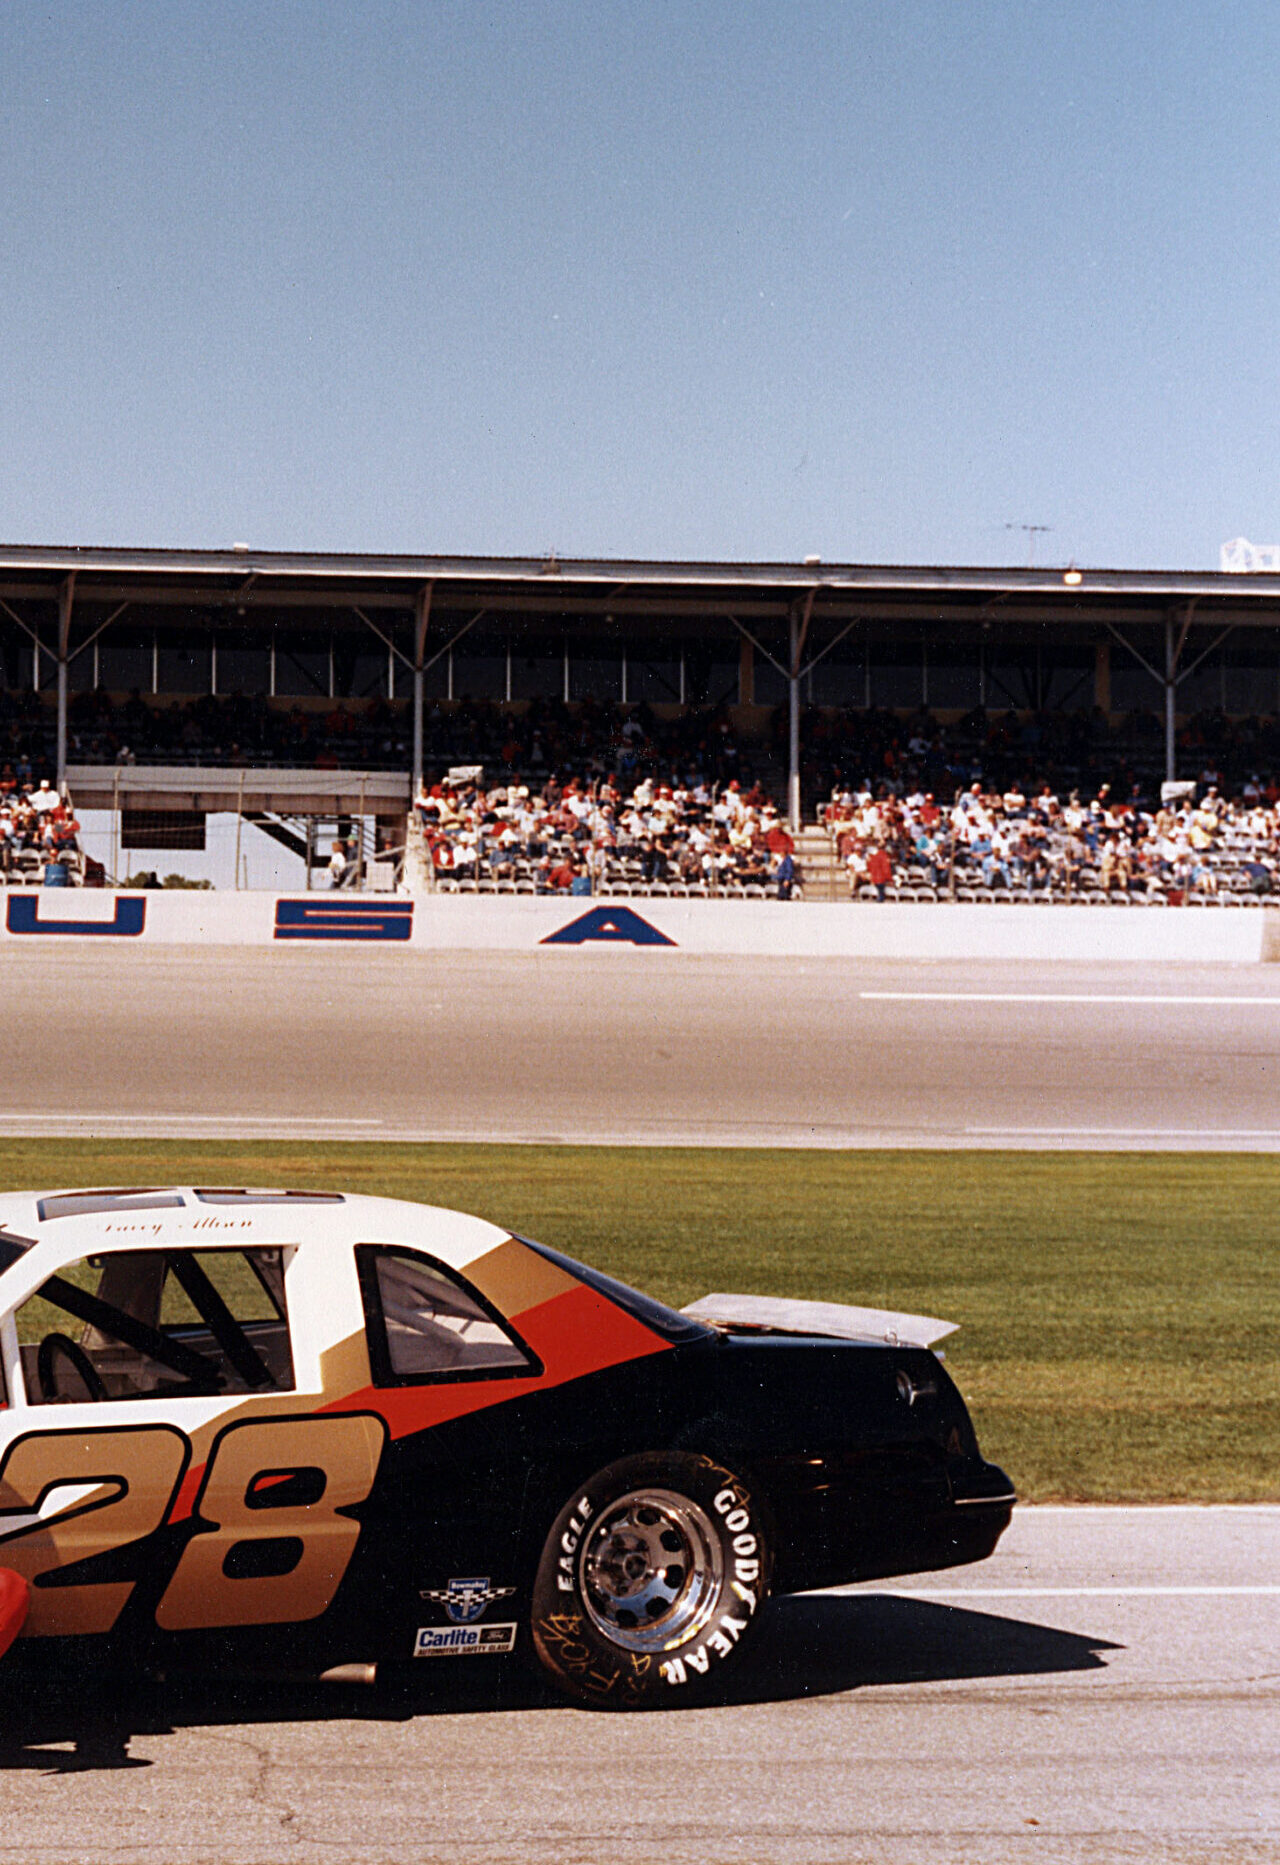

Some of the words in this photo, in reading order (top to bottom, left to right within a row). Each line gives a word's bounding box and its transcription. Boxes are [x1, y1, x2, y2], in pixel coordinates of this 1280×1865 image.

[6, 892, 679, 946] USA
[557, 1496, 594, 1593] EAGLE
[663, 1489, 760, 1686] GOODYEAR
[420, 1629, 478, 1648] Carlite
